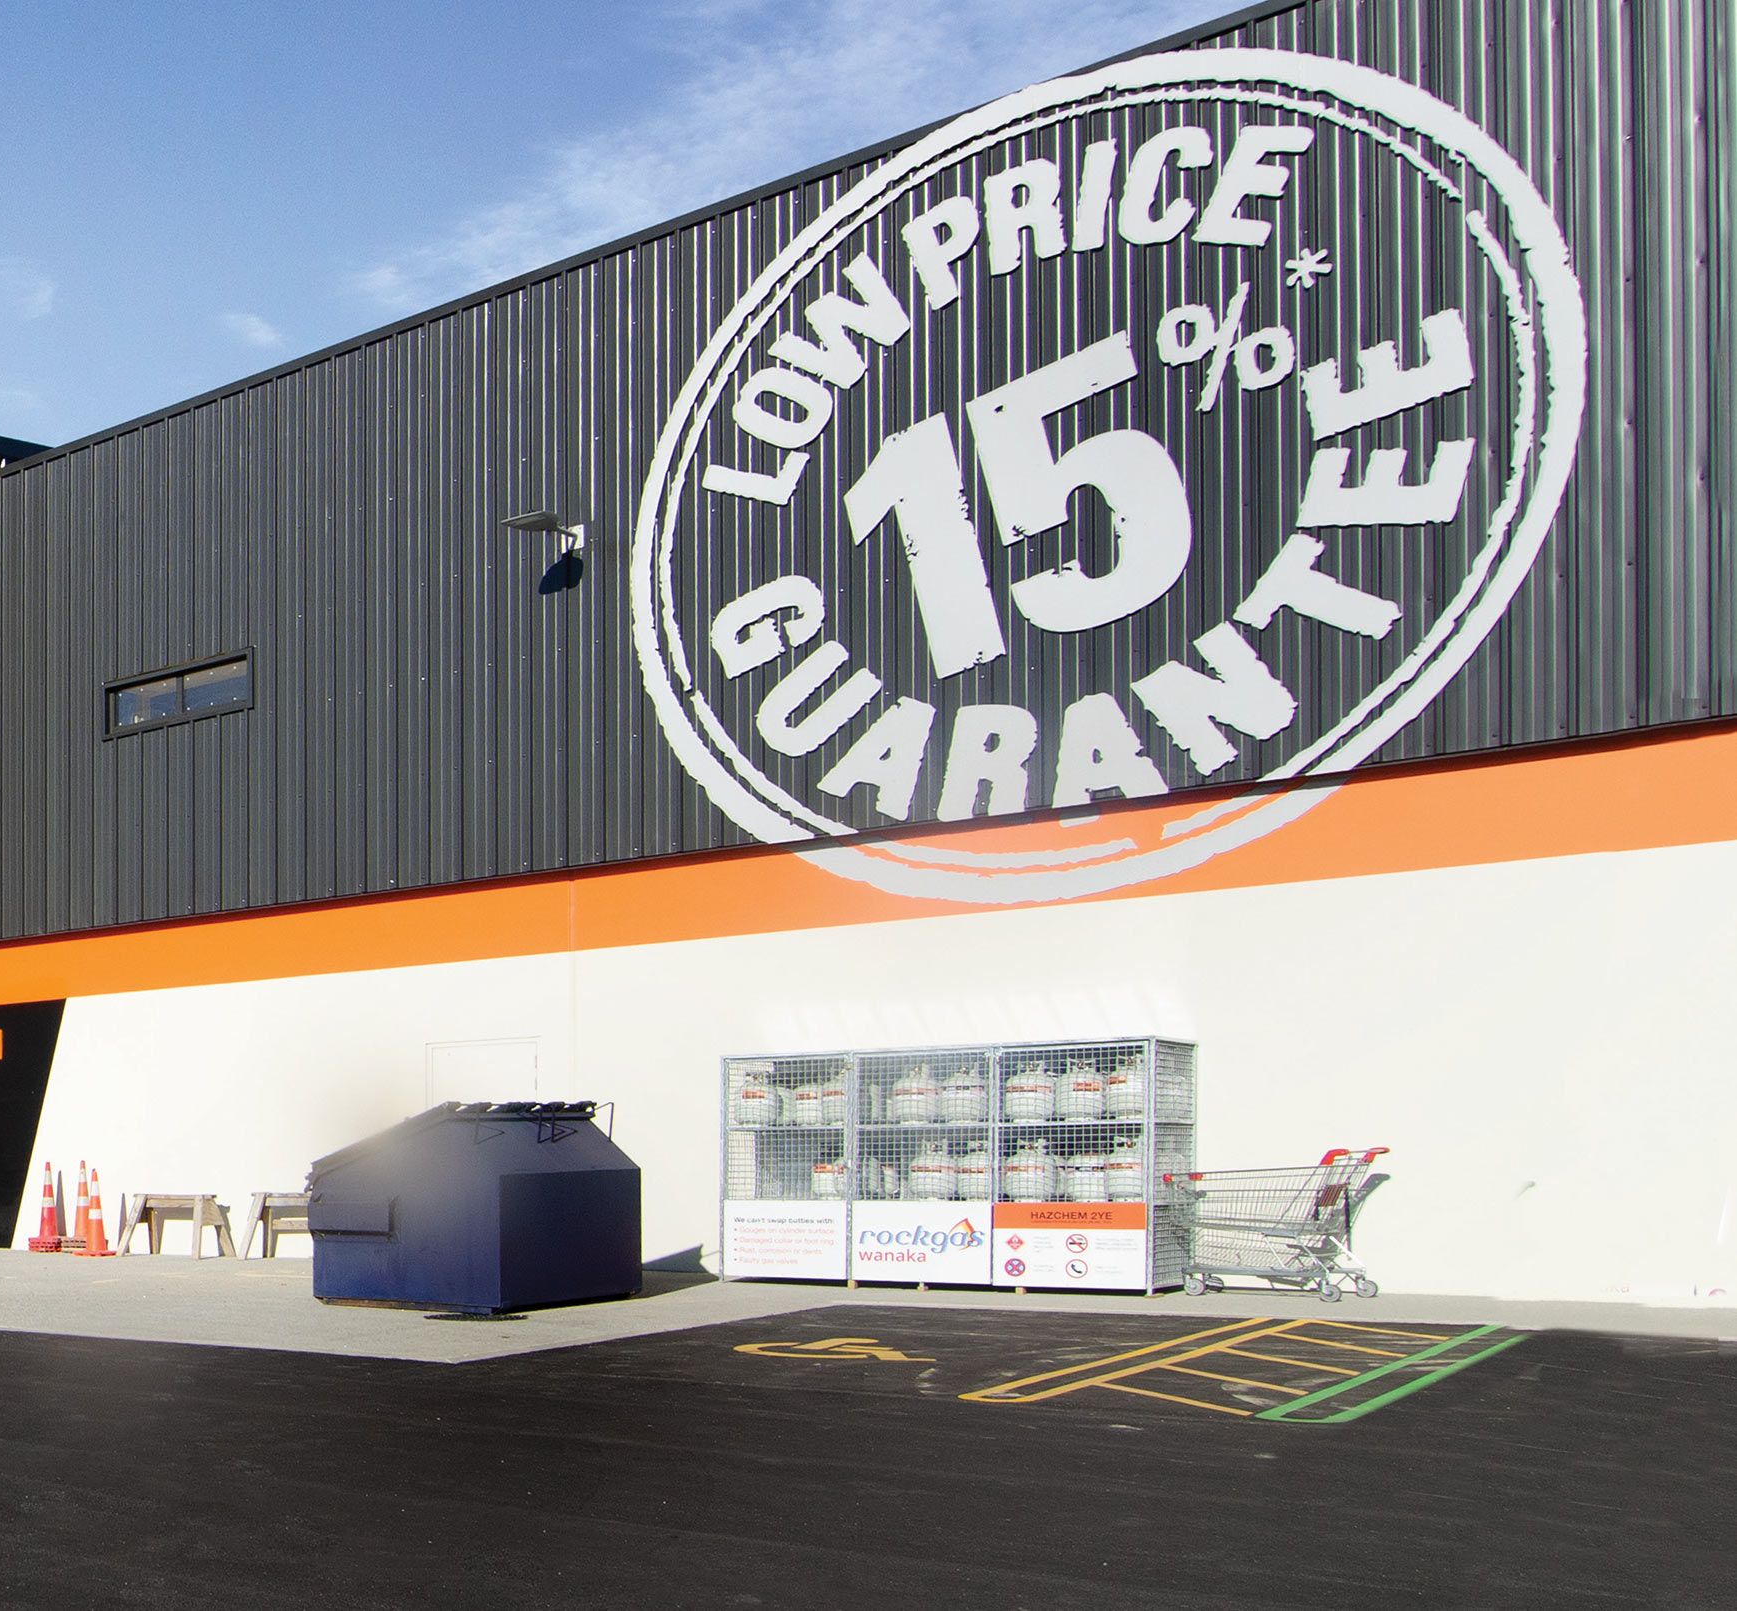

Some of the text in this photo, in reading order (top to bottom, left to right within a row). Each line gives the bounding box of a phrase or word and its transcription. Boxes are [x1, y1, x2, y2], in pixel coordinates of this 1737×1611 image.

[702, 124, 1314, 507] LOW PRICE
[709, 308, 1474, 827] GUARANTEE
[1030, 1211, 1113, 1220] HAZCHEM 2YE
[859, 1224, 985, 1254] rockgas
[858, 1249, 927, 1263] wanaka
